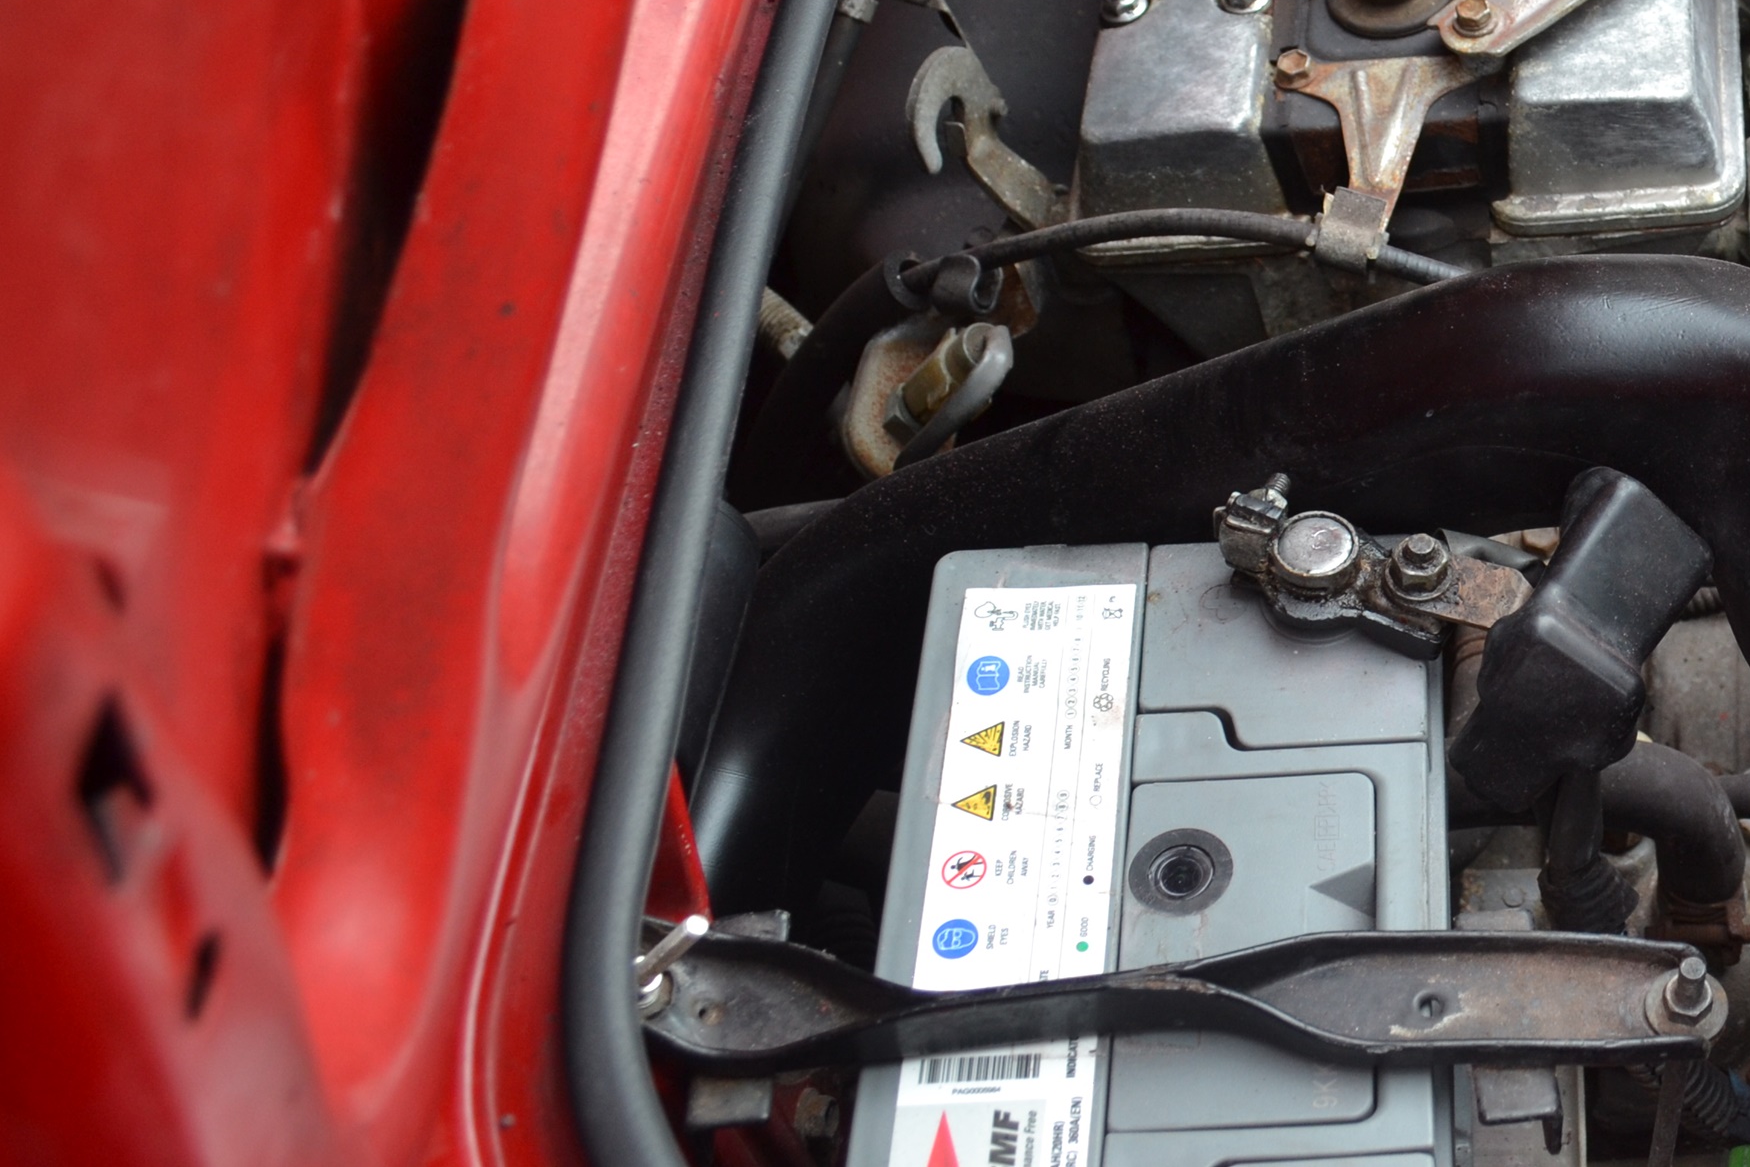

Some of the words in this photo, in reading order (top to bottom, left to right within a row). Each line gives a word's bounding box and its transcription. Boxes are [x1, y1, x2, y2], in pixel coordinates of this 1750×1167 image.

[1017, 666, 1025, 683] READ
[1023, 655, 1033, 694] INSTRUCTION
[1032, 661, 1040, 687] MANUAL
[1100, 658, 1111, 692] RECYCLING
[1008, 720, 1020, 757] EXPLOSION
[1022, 724, 1032, 752] HAZARD
[1063, 725, 1073, 750] MONTH
[1093, 763, 1104, 792] REPLACE
[1015, 788, 1025, 816] HAZARD
[1086, 835, 1096, 872] CHARGING
[995, 859, 1003, 877] KEEP
[1006, 850, 1017, 885] CHILDREN
[1020, 857, 1029, 877] AWAY
[1046, 910, 1055, 929] YEAR
[1080, 917, 1089, 937] GOOD
[986, 924, 996, 950] SHIELD
[999, 927, 1009, 946] EYES
[1023, 1109, 1038, 1135] Free
[987, 1109, 1020, 1167] MF
